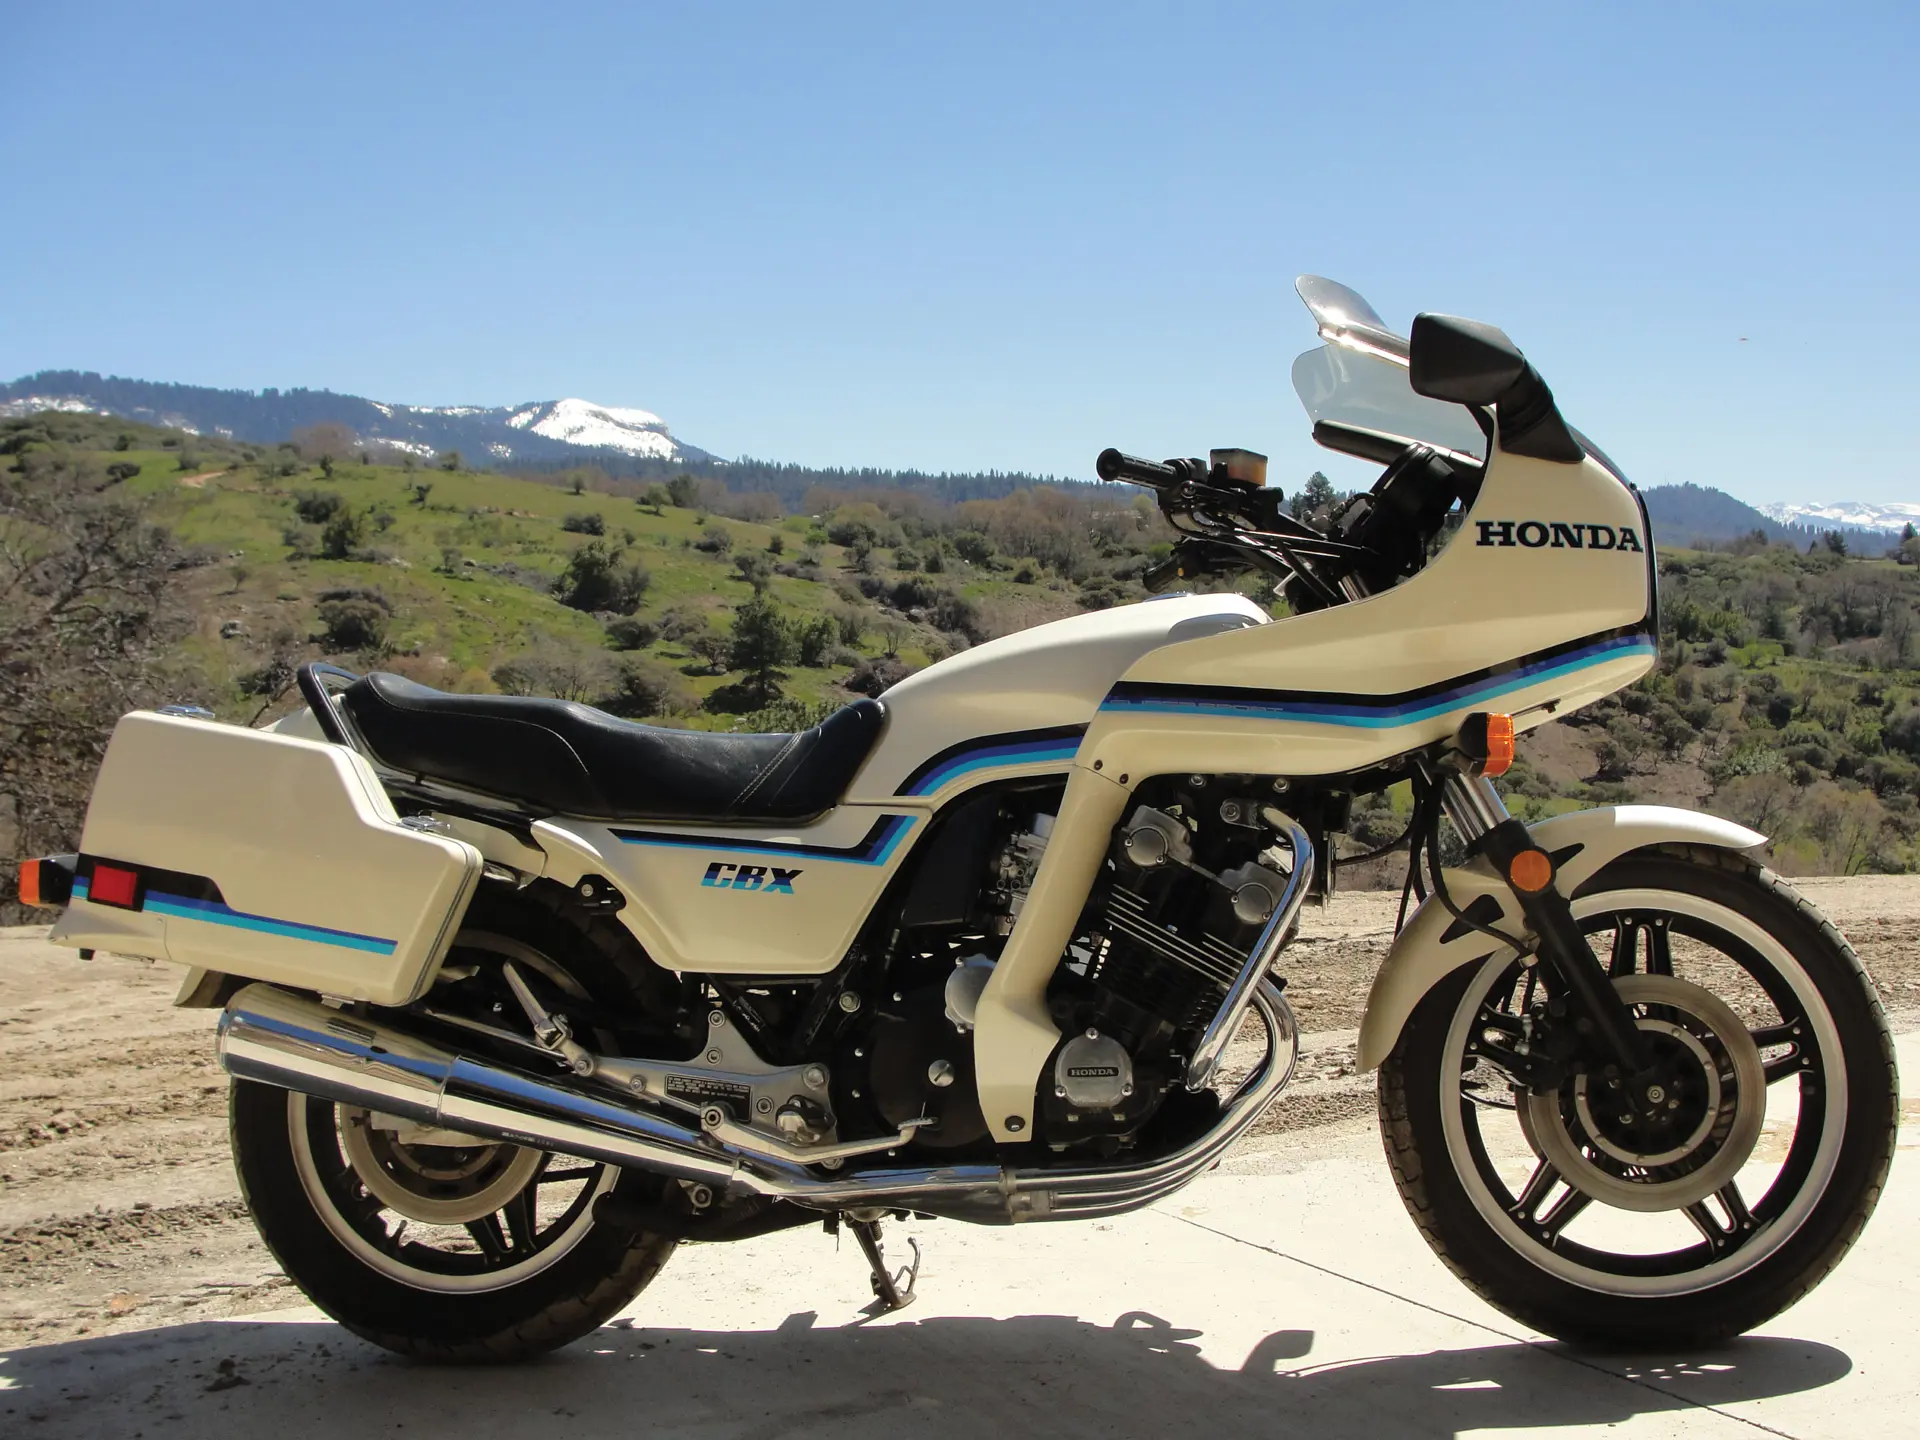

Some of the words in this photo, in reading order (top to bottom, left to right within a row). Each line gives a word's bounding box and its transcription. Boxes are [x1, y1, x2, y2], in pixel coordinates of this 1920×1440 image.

[1475, 521, 1644, 552] HONDA
[701, 862, 804, 894] CBX
[1071, 1068, 1115, 1076] HONDA
